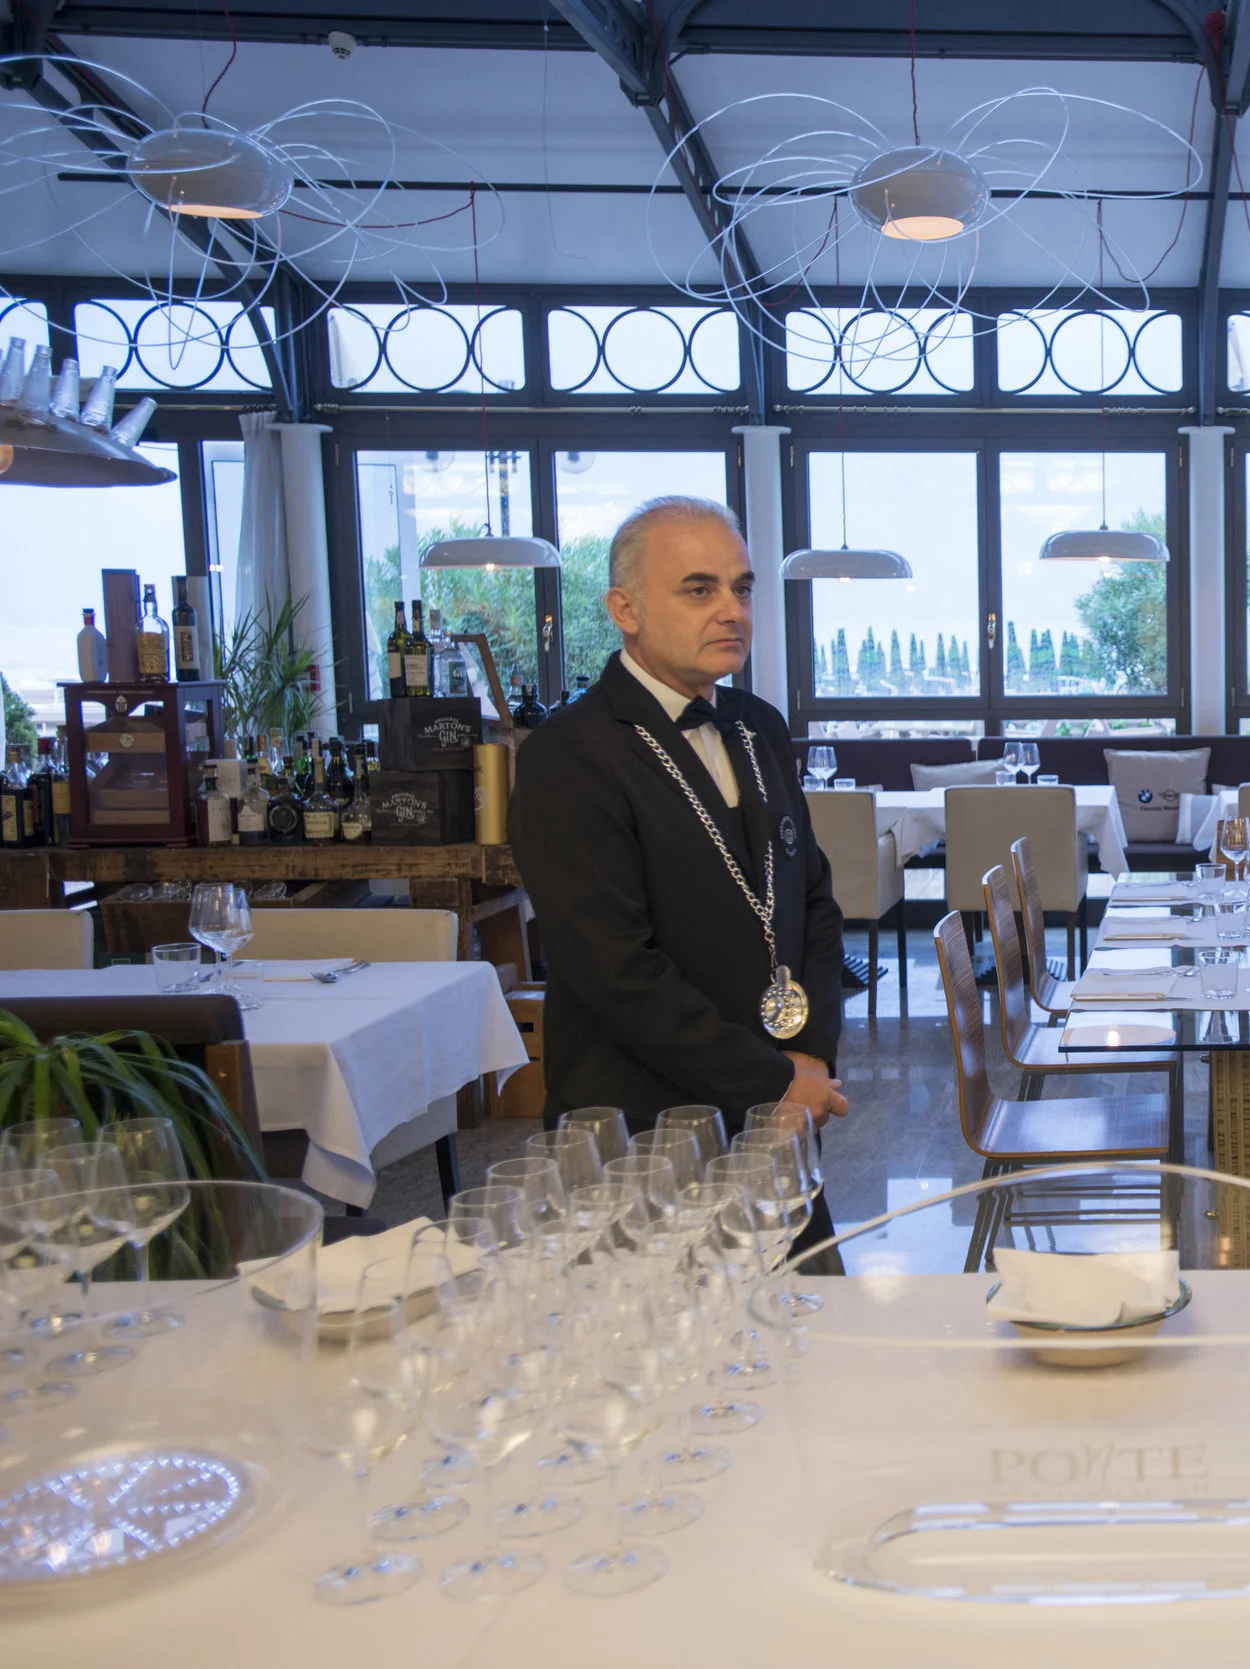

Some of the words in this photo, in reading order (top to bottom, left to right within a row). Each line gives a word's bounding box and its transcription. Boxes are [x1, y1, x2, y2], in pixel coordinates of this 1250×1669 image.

[439, 730, 458, 747] GIN
[396, 806, 415, 822] GIN
[989, 1440, 1210, 1495] PONTE
